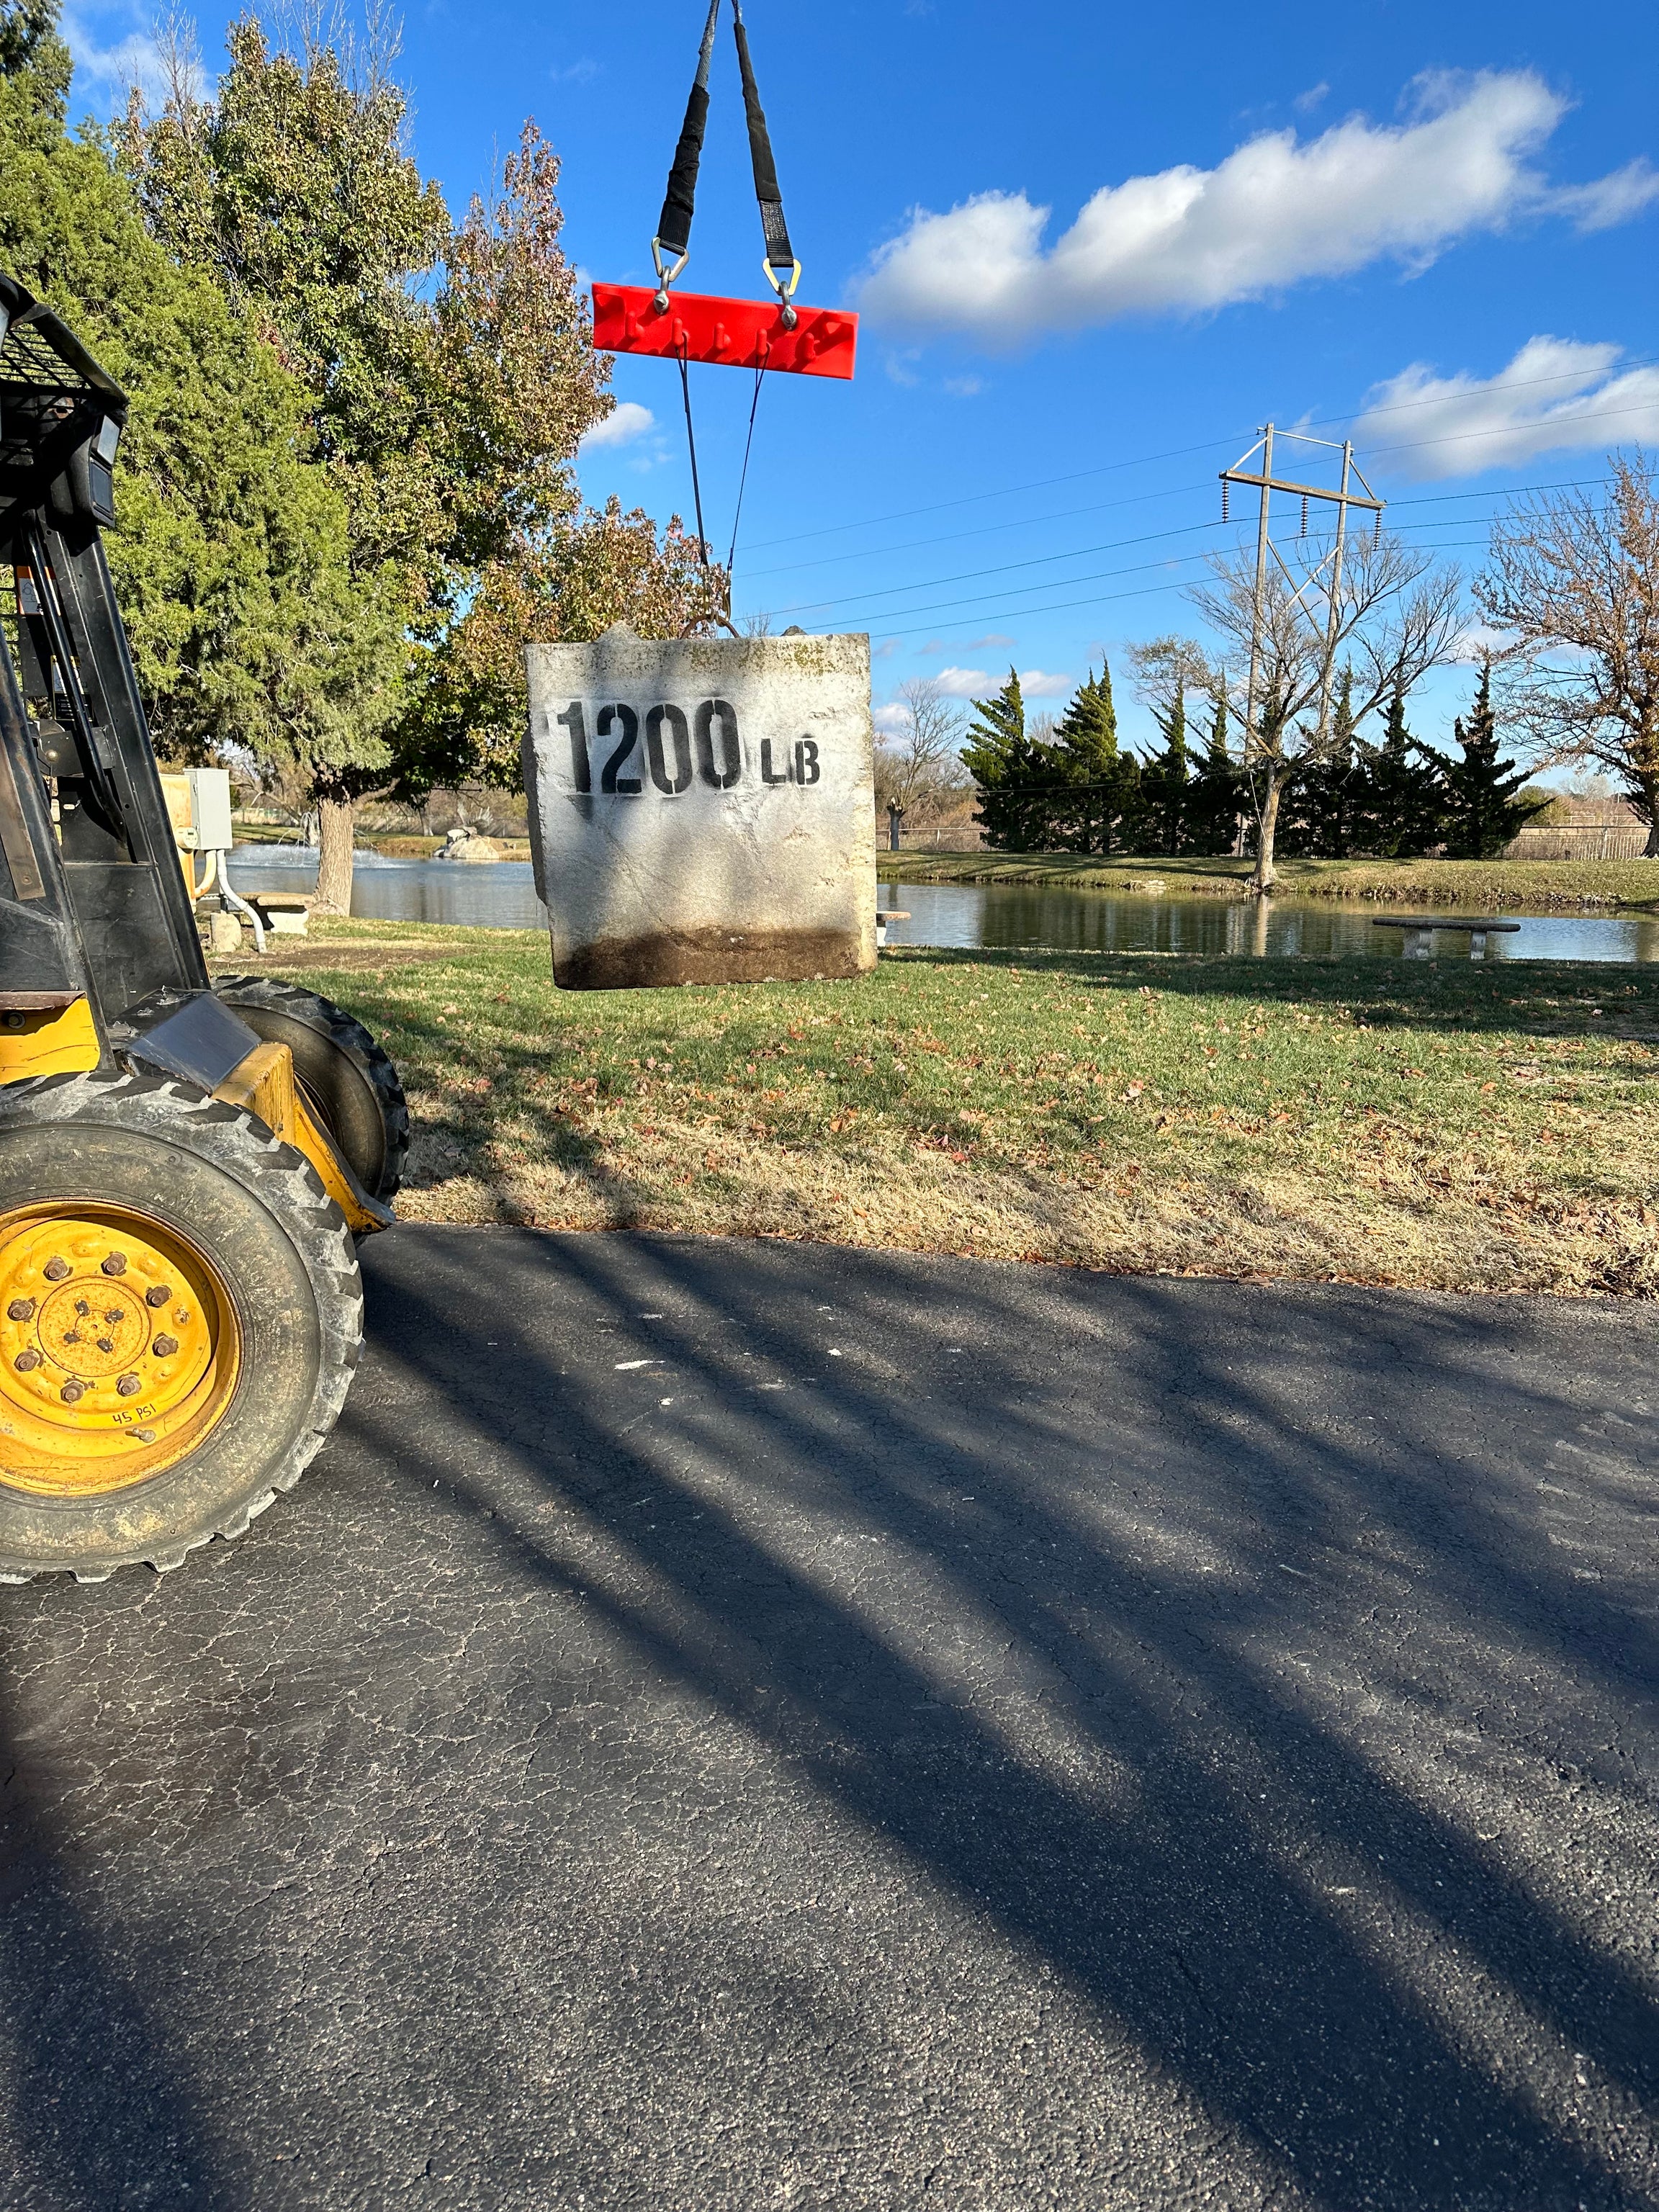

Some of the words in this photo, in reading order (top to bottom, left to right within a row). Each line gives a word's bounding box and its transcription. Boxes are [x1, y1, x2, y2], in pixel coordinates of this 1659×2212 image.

[557, 700, 740, 794] 1200
[760, 738, 820, 785] LB
[112, 1411, 132, 1424] 45
[135, 1403, 156, 1420] PSI
